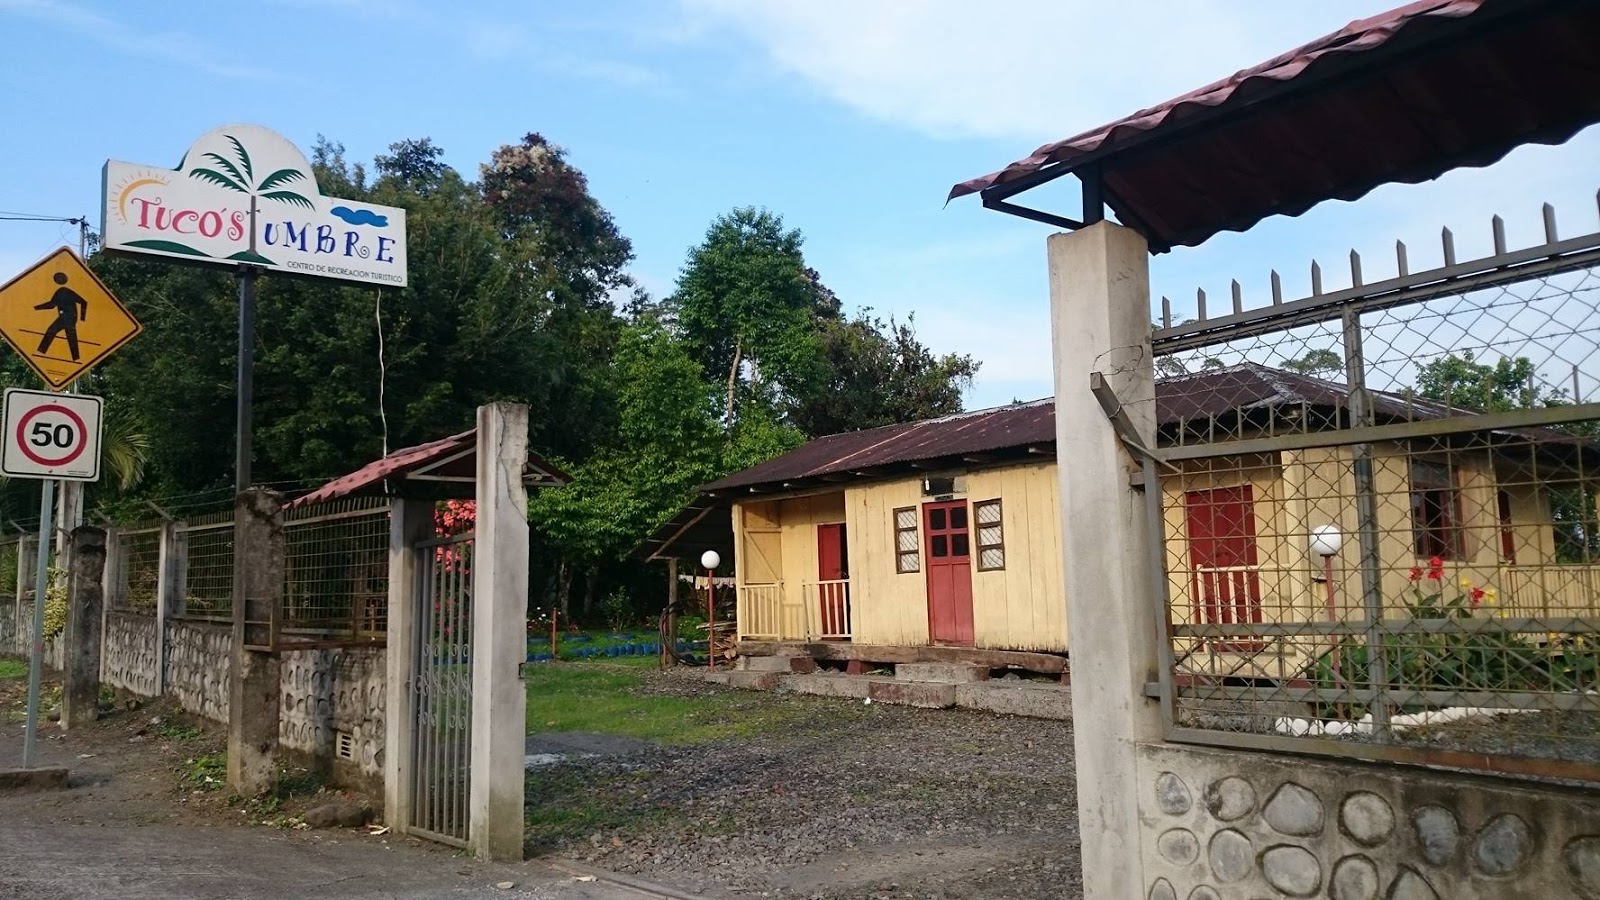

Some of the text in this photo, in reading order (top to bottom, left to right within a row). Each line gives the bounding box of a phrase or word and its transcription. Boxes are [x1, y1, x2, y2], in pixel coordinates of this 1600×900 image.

[287, 260, 403, 283] CENTRO DE RECREACION TURISTICO
[31, 422, 74, 448] 50
